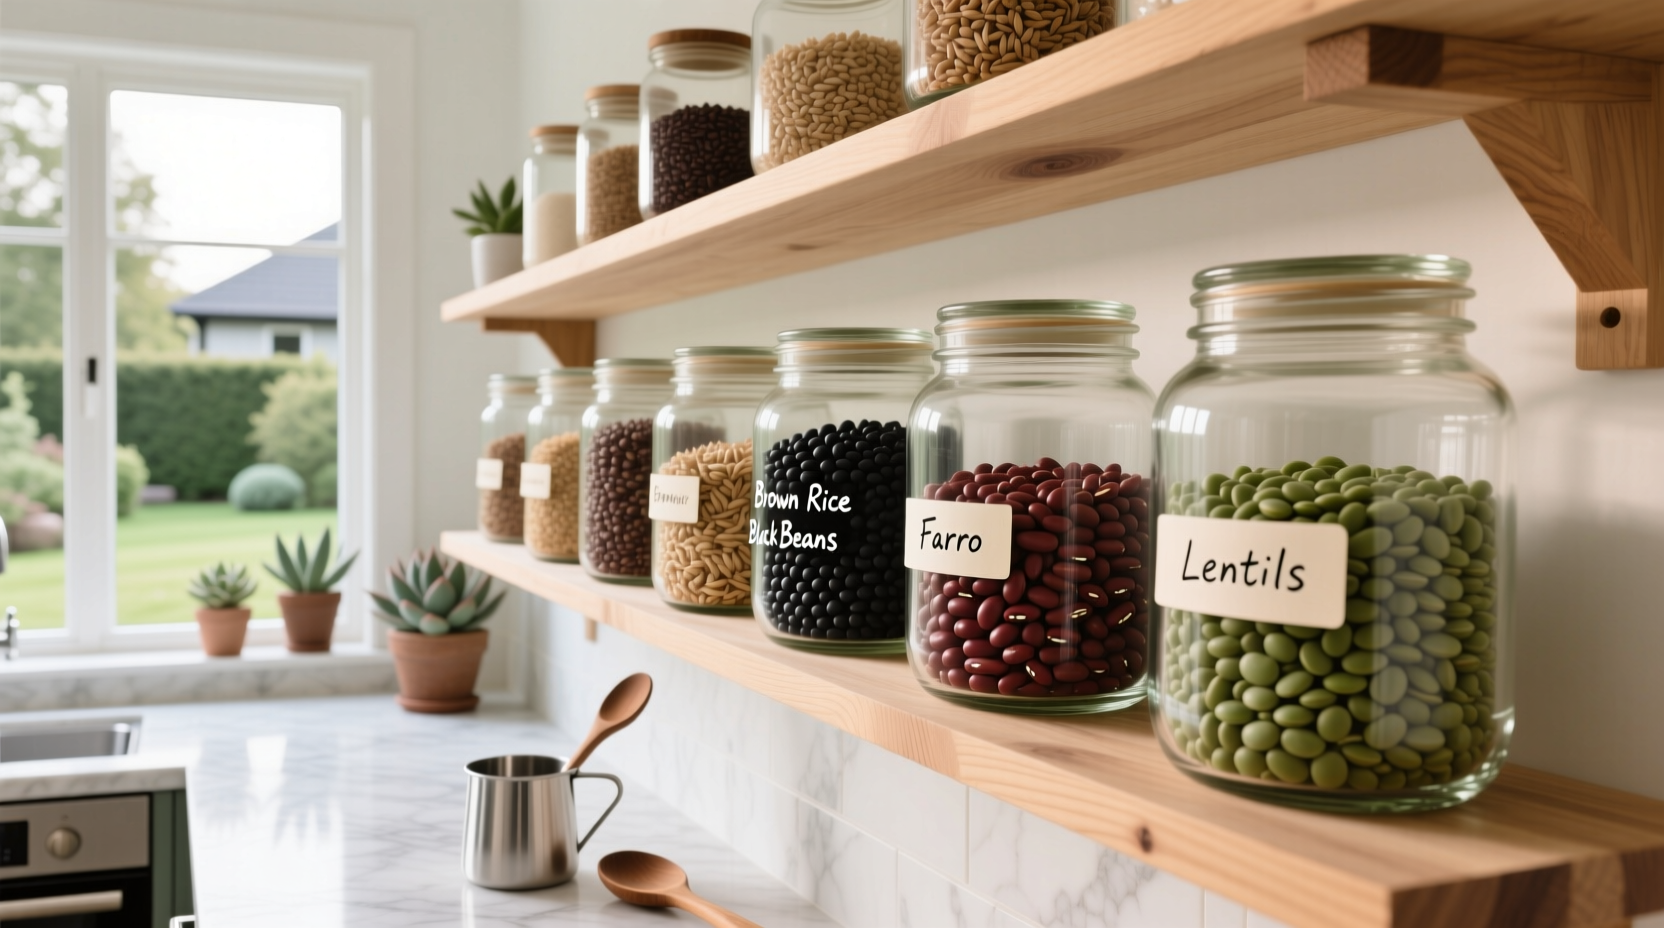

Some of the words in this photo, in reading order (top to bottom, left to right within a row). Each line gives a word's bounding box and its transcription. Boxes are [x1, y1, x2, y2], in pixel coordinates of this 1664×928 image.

[754, 480, 799, 510] Brown
[806, 483, 852, 513] Rice
[779, 519, 838, 552] Beans
[920, 516, 982, 553] Farro
[1182, 539, 1306, 592] Lentils
